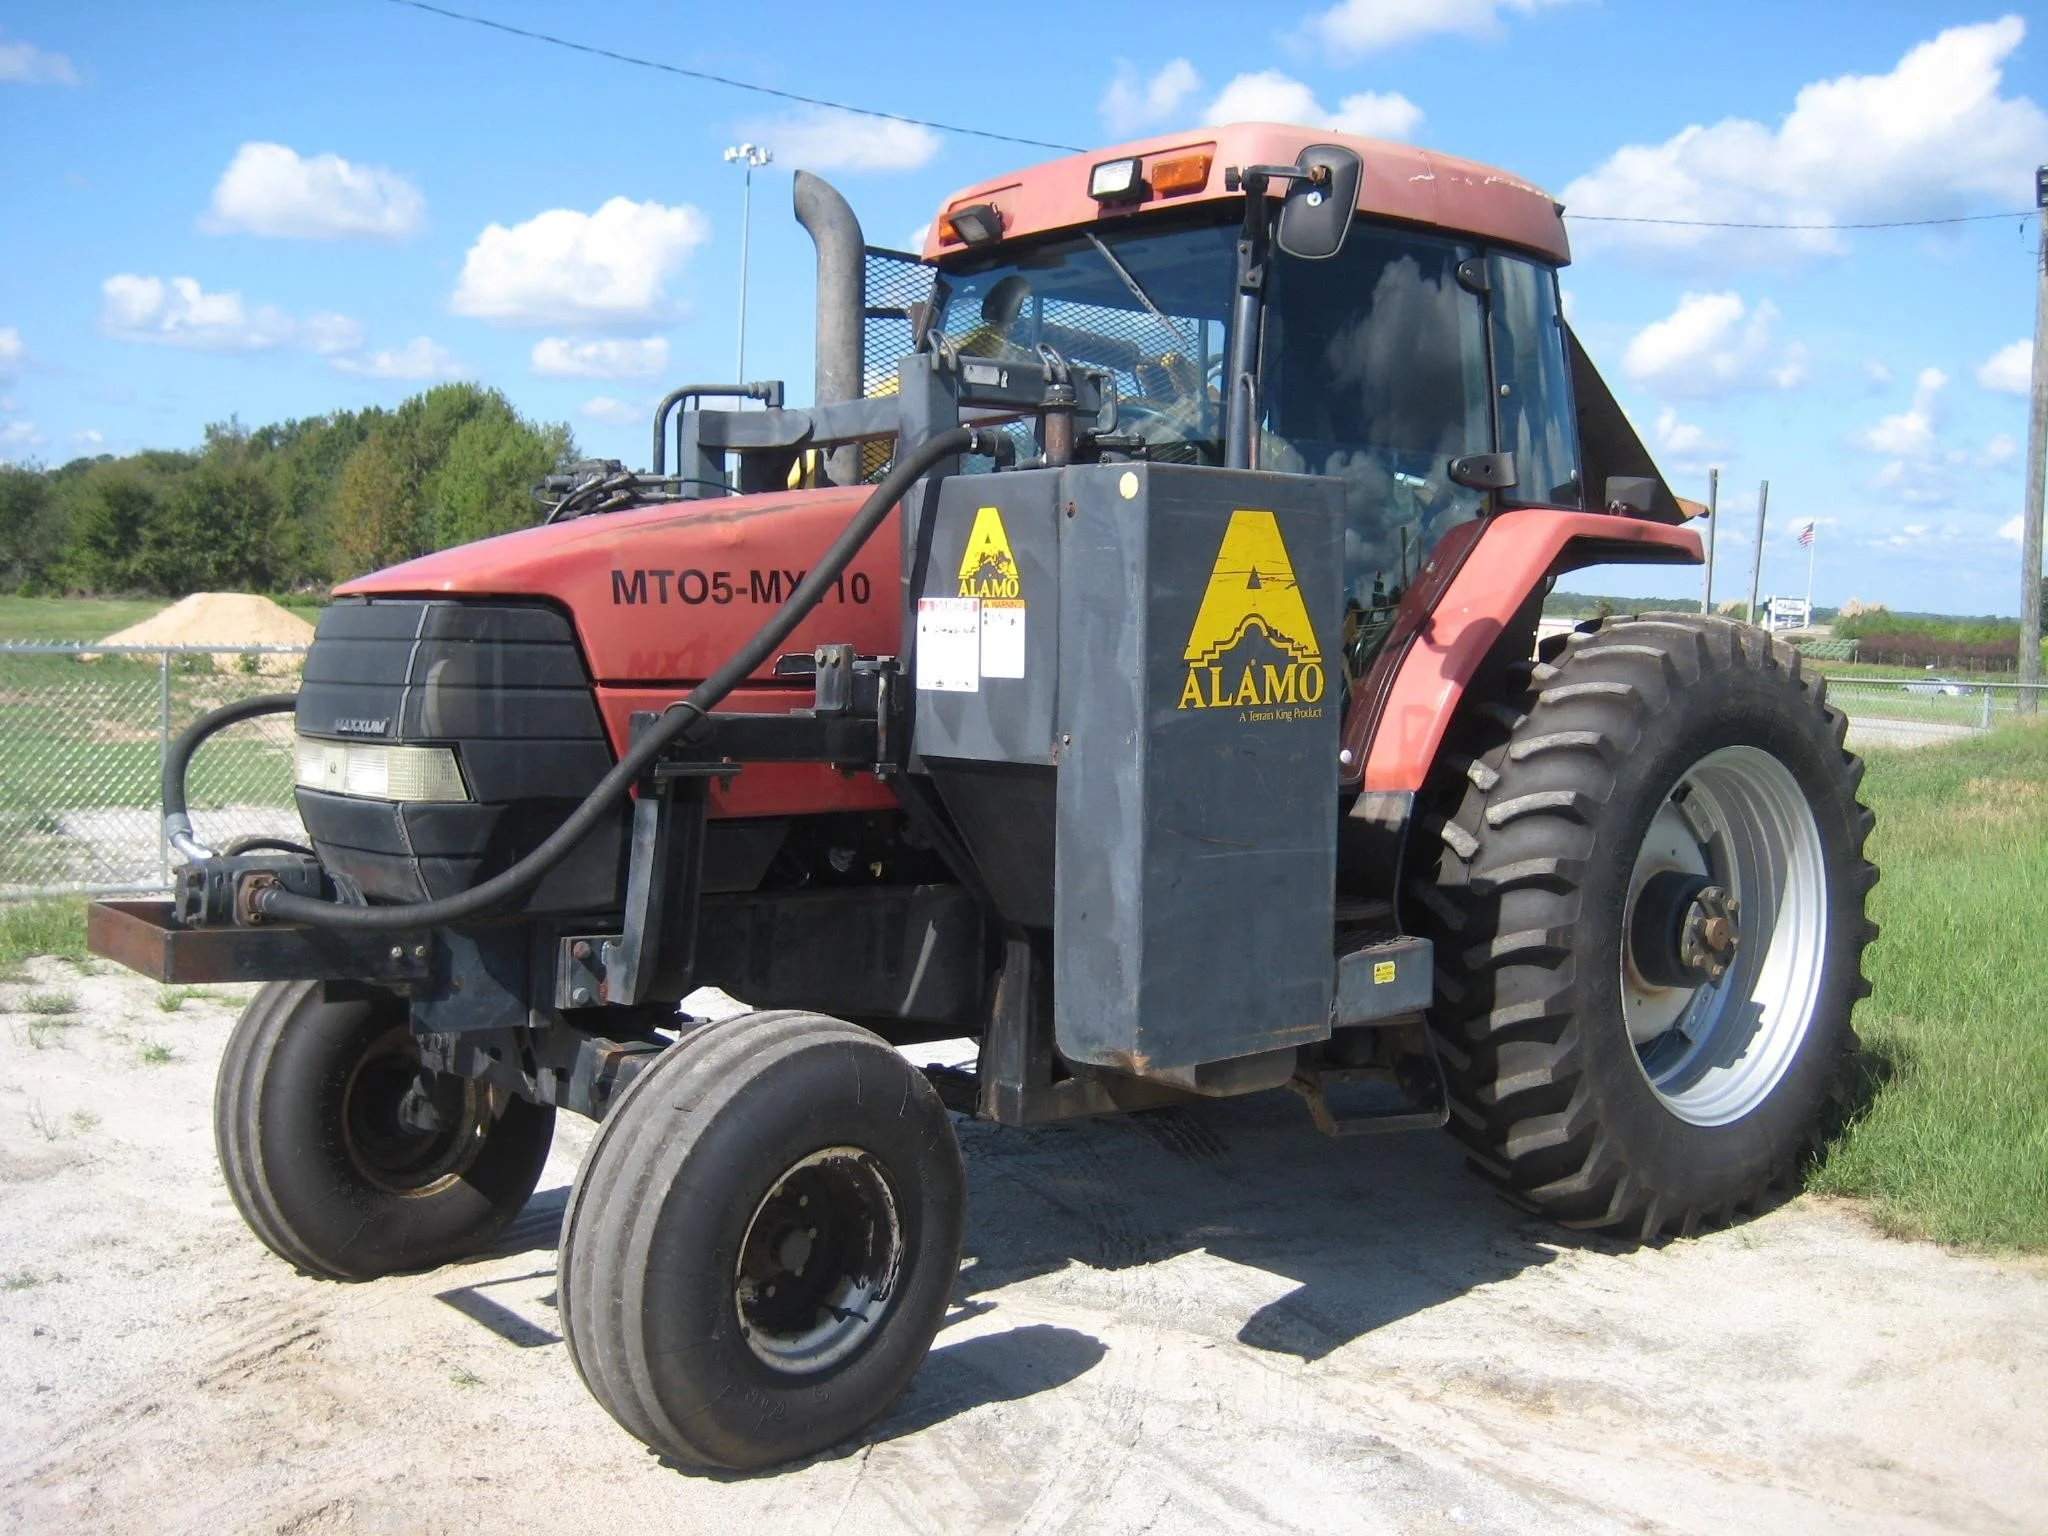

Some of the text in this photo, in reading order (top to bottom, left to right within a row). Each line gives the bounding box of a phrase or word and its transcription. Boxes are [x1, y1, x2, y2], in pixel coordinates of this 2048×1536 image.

[611, 569, 870, 605] MTO5-MX10
[958, 577, 1020, 598] ALAMO
[1177, 663, 1325, 709] ALAMO
[1239, 706, 1322, 722] A Terrain King Product
[335, 719, 388, 733] MAXXUM
